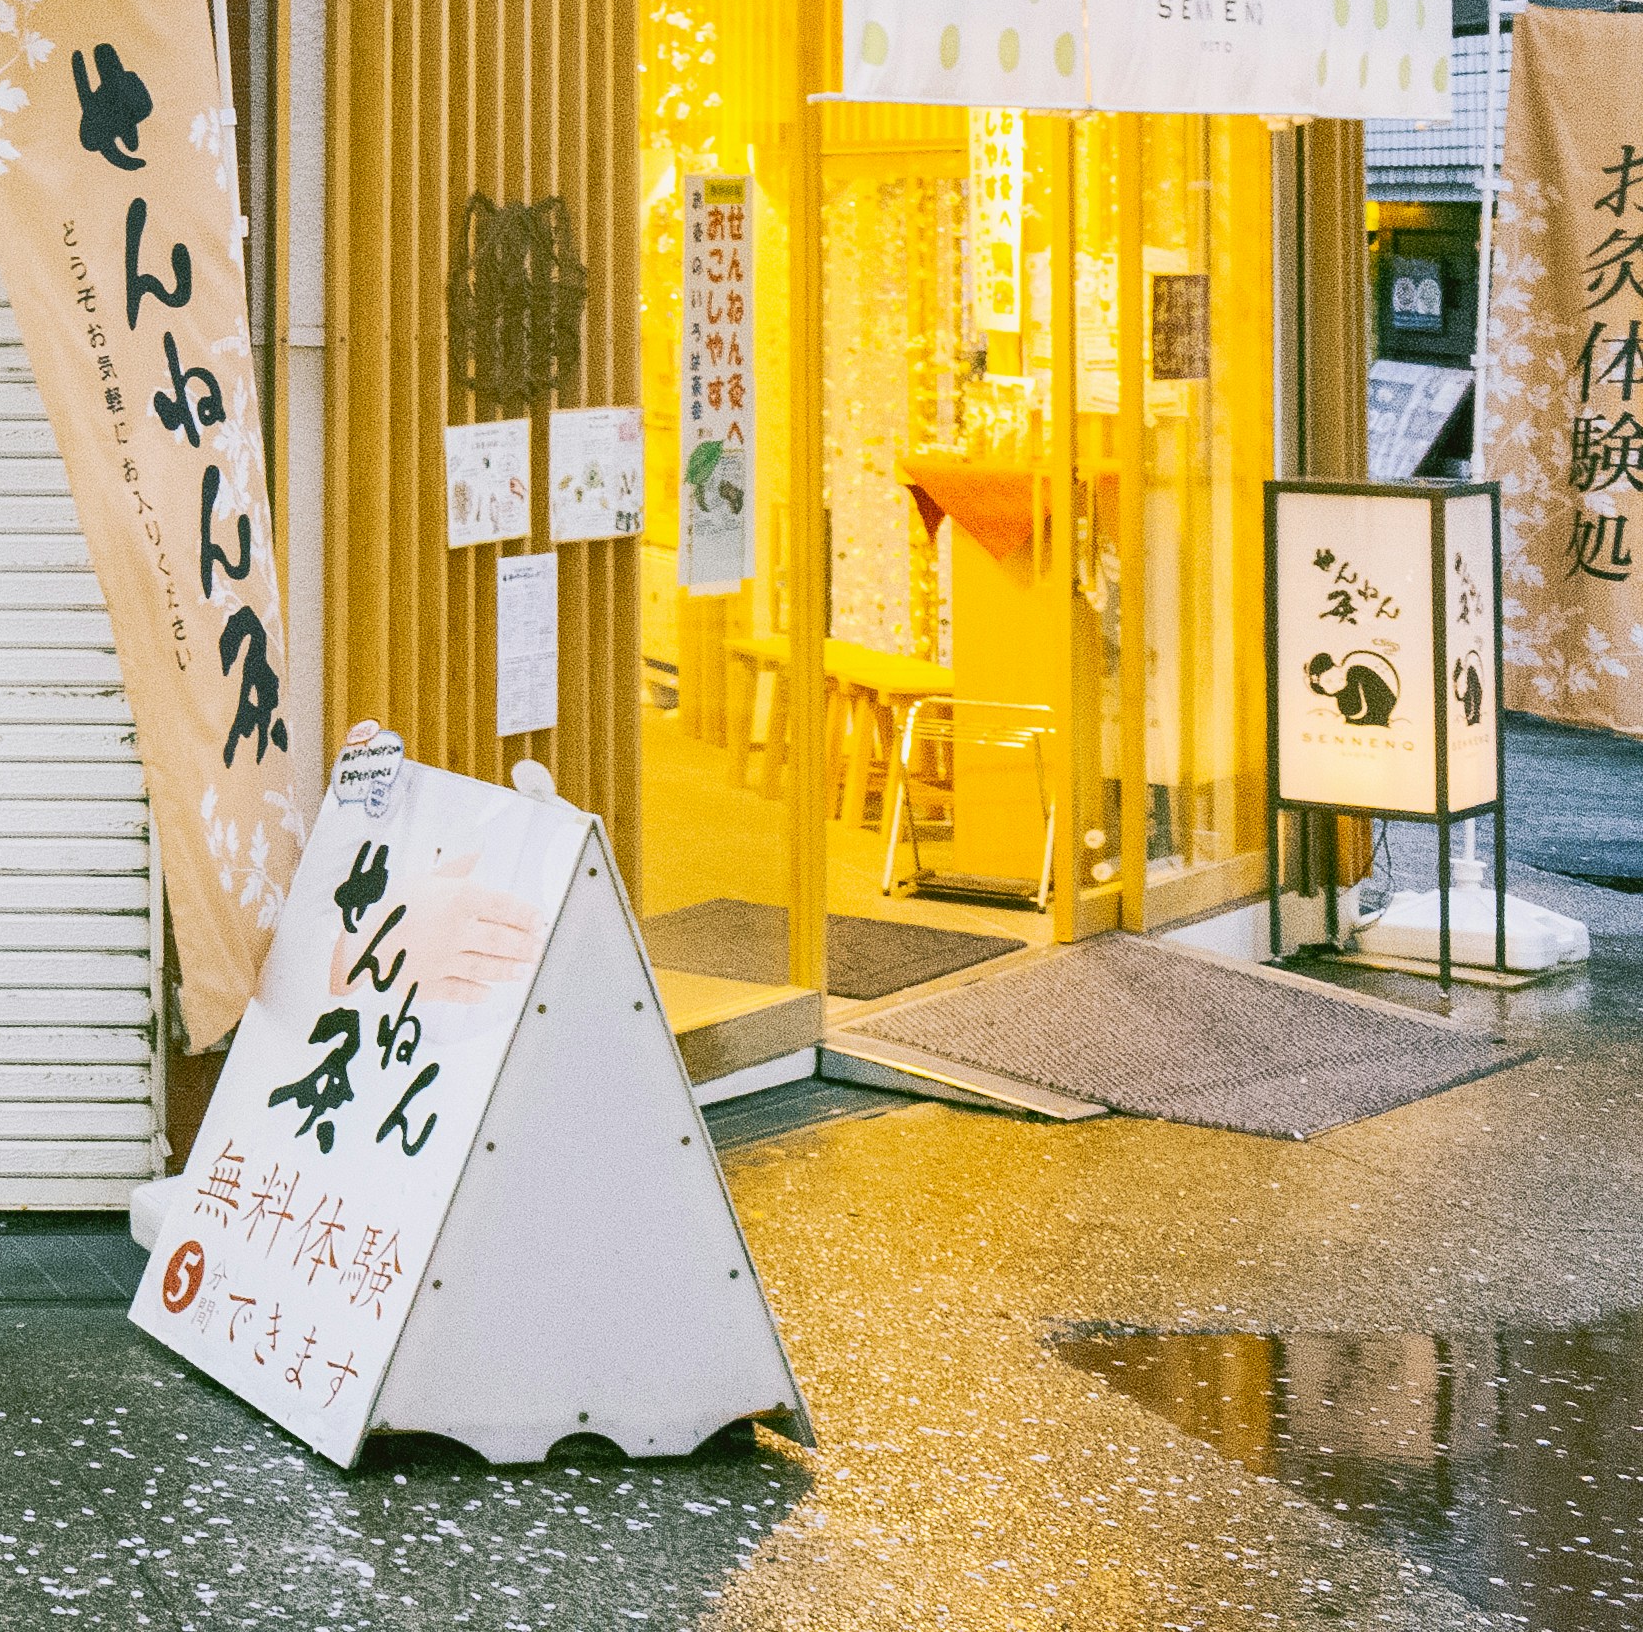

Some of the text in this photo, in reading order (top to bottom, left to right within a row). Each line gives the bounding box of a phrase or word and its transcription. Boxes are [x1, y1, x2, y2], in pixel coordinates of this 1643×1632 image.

[71, 42, 289, 769] せんねん灸
[705, 206, 725, 412] おこしやす
[1566, 144, 1643, 583] お灸体験処
[1313, 548, 1401, 625] せんねん灸
[193, 1138, 403, 1321] 無料体験
